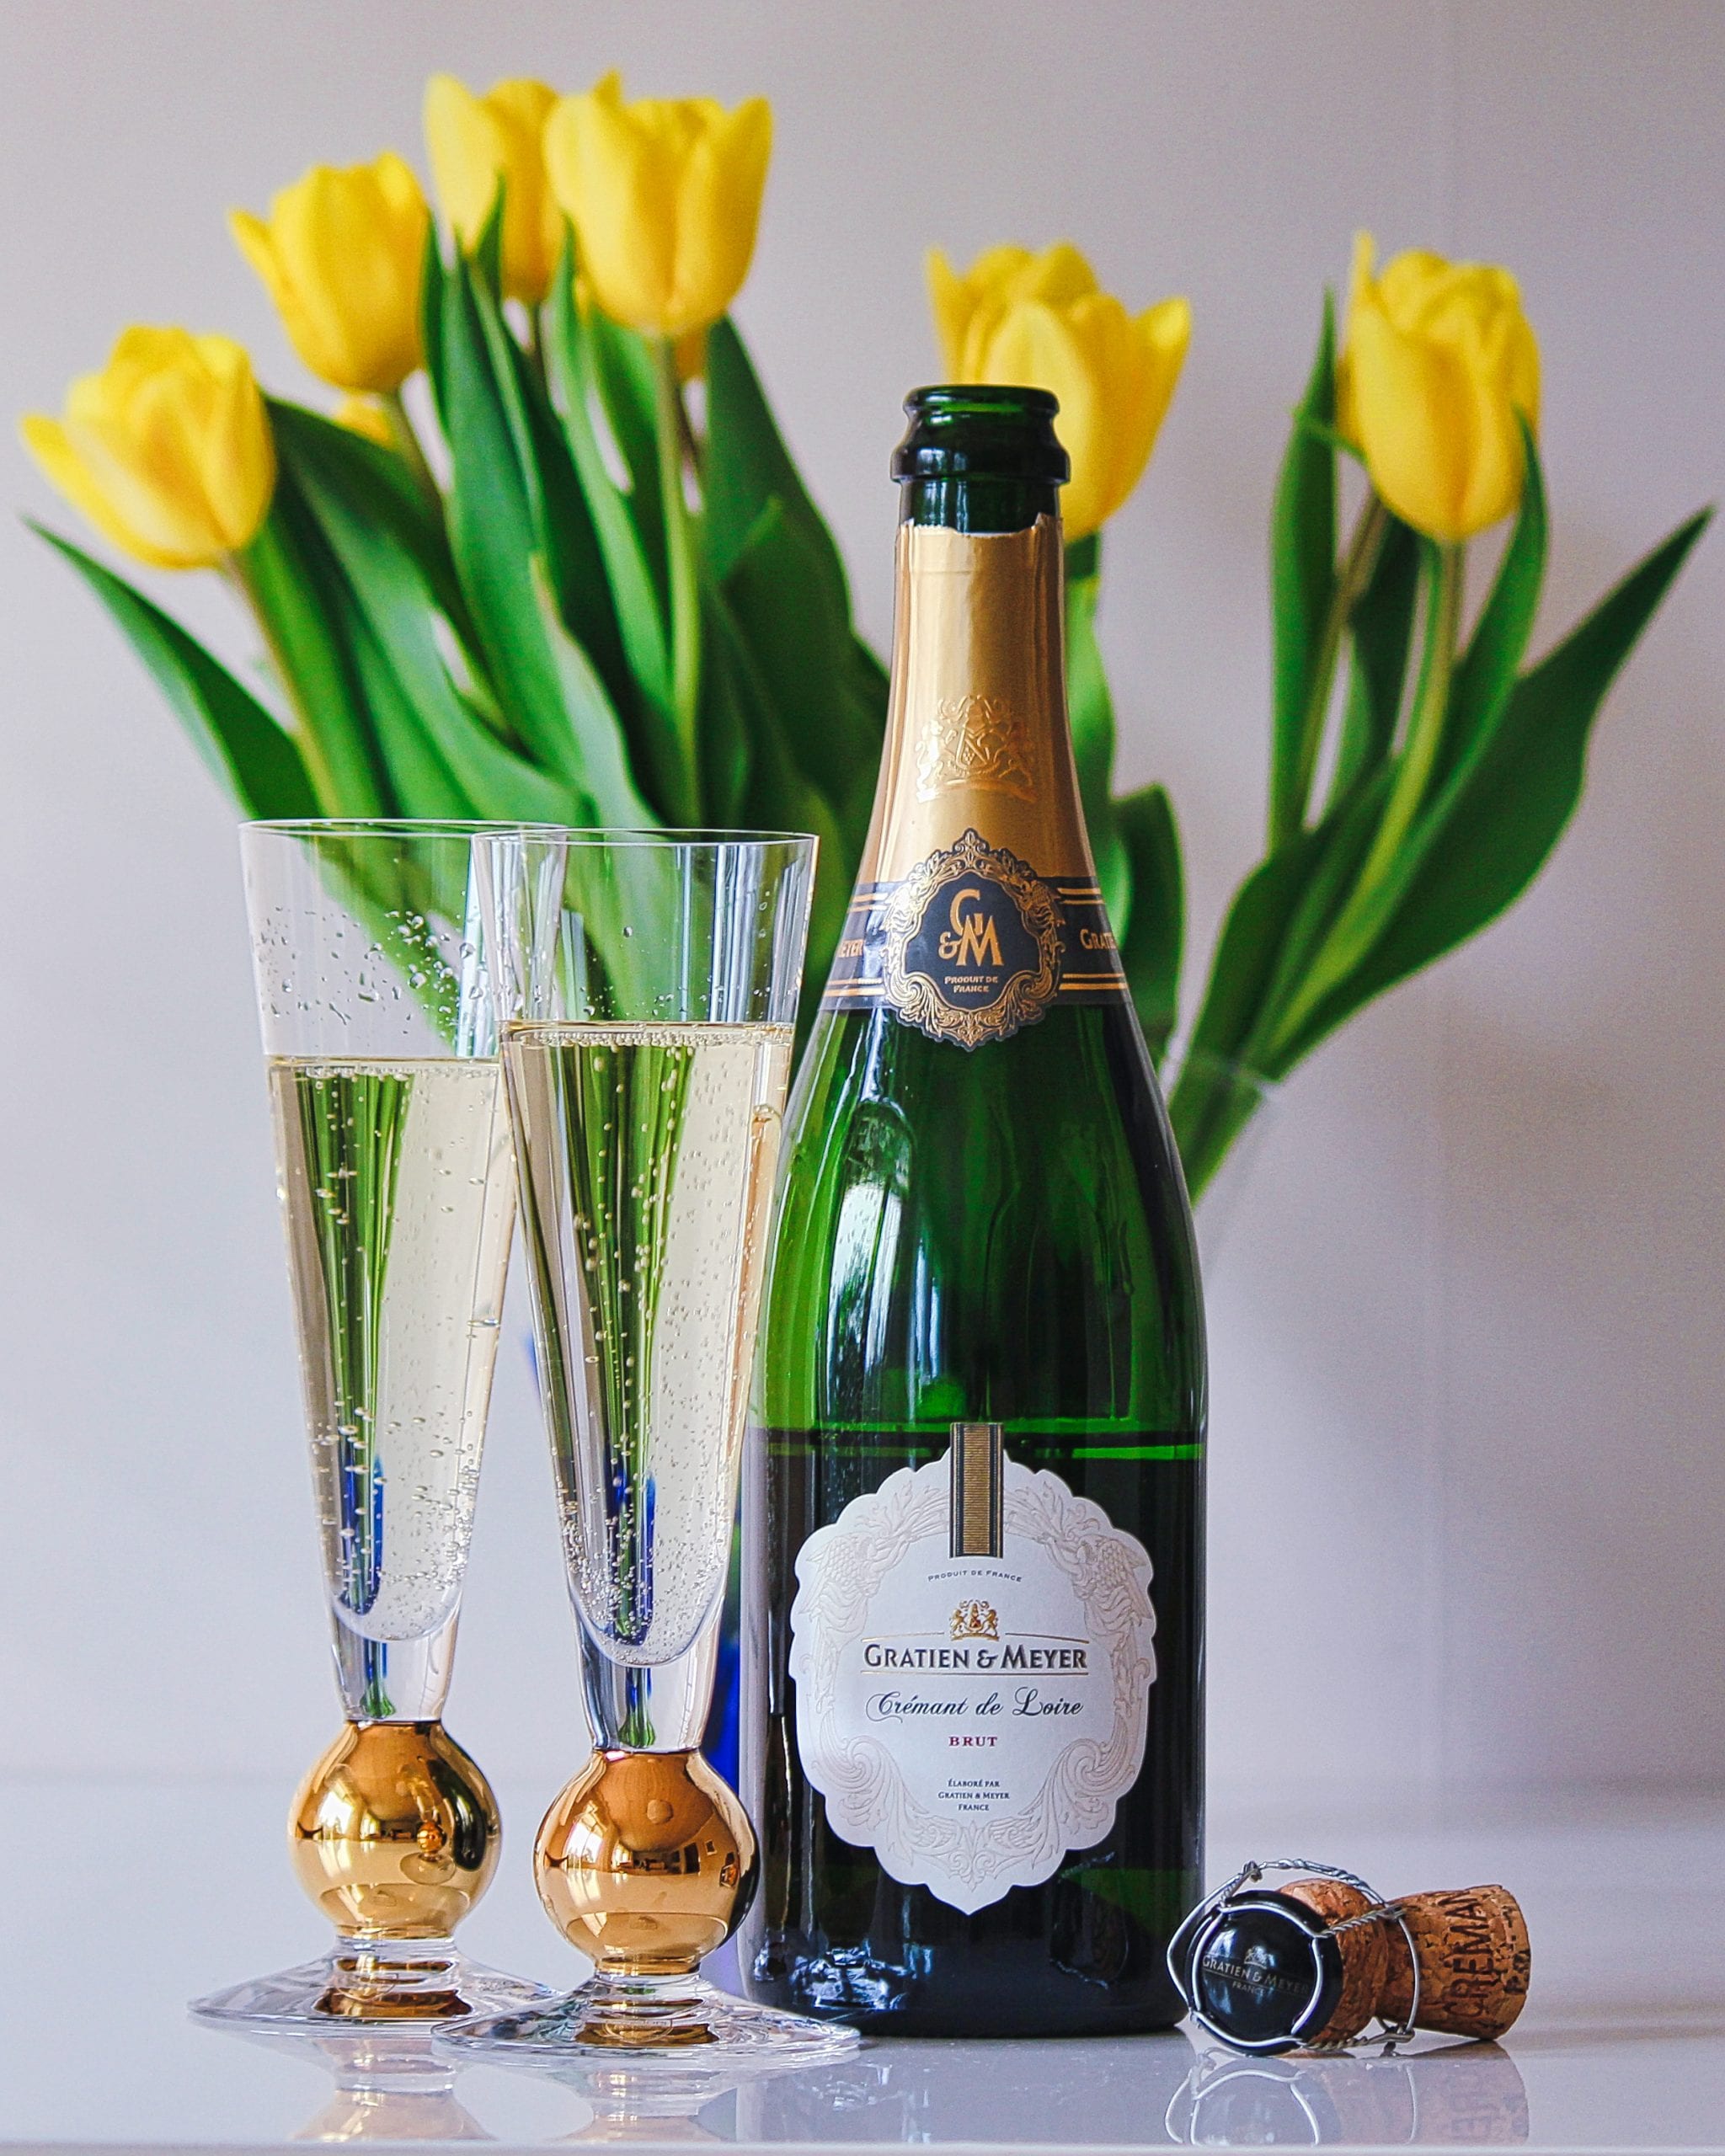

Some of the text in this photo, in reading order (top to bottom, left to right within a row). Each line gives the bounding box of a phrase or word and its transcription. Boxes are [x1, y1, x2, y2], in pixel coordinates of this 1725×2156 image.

[944, 975, 999, 985] PRODUIT DE
[953, 985, 990, 994] FRANCE
[927, 1569, 968, 1582] PRODUIT
[985, 1569, 1023, 1583] FRANCE
[863, 1643, 1088, 1670] GRATIEN & MEYER
[866, 1686, 1084, 1724] Crémant de Loire
[948, 1736, 999, 1748] BRUT
[948, 1778, 984, 1787] ÉLABORÉ
[937, 1790, 973, 1800] GRATIEN
[982, 1791, 1011, 1800] MEYER
[958, 1803, 990, 1812] FRANCE
[1202, 1954, 1311, 1995] GRATIEN & MEYER
[1232, 1980, 1266, 1997] FRANCE
